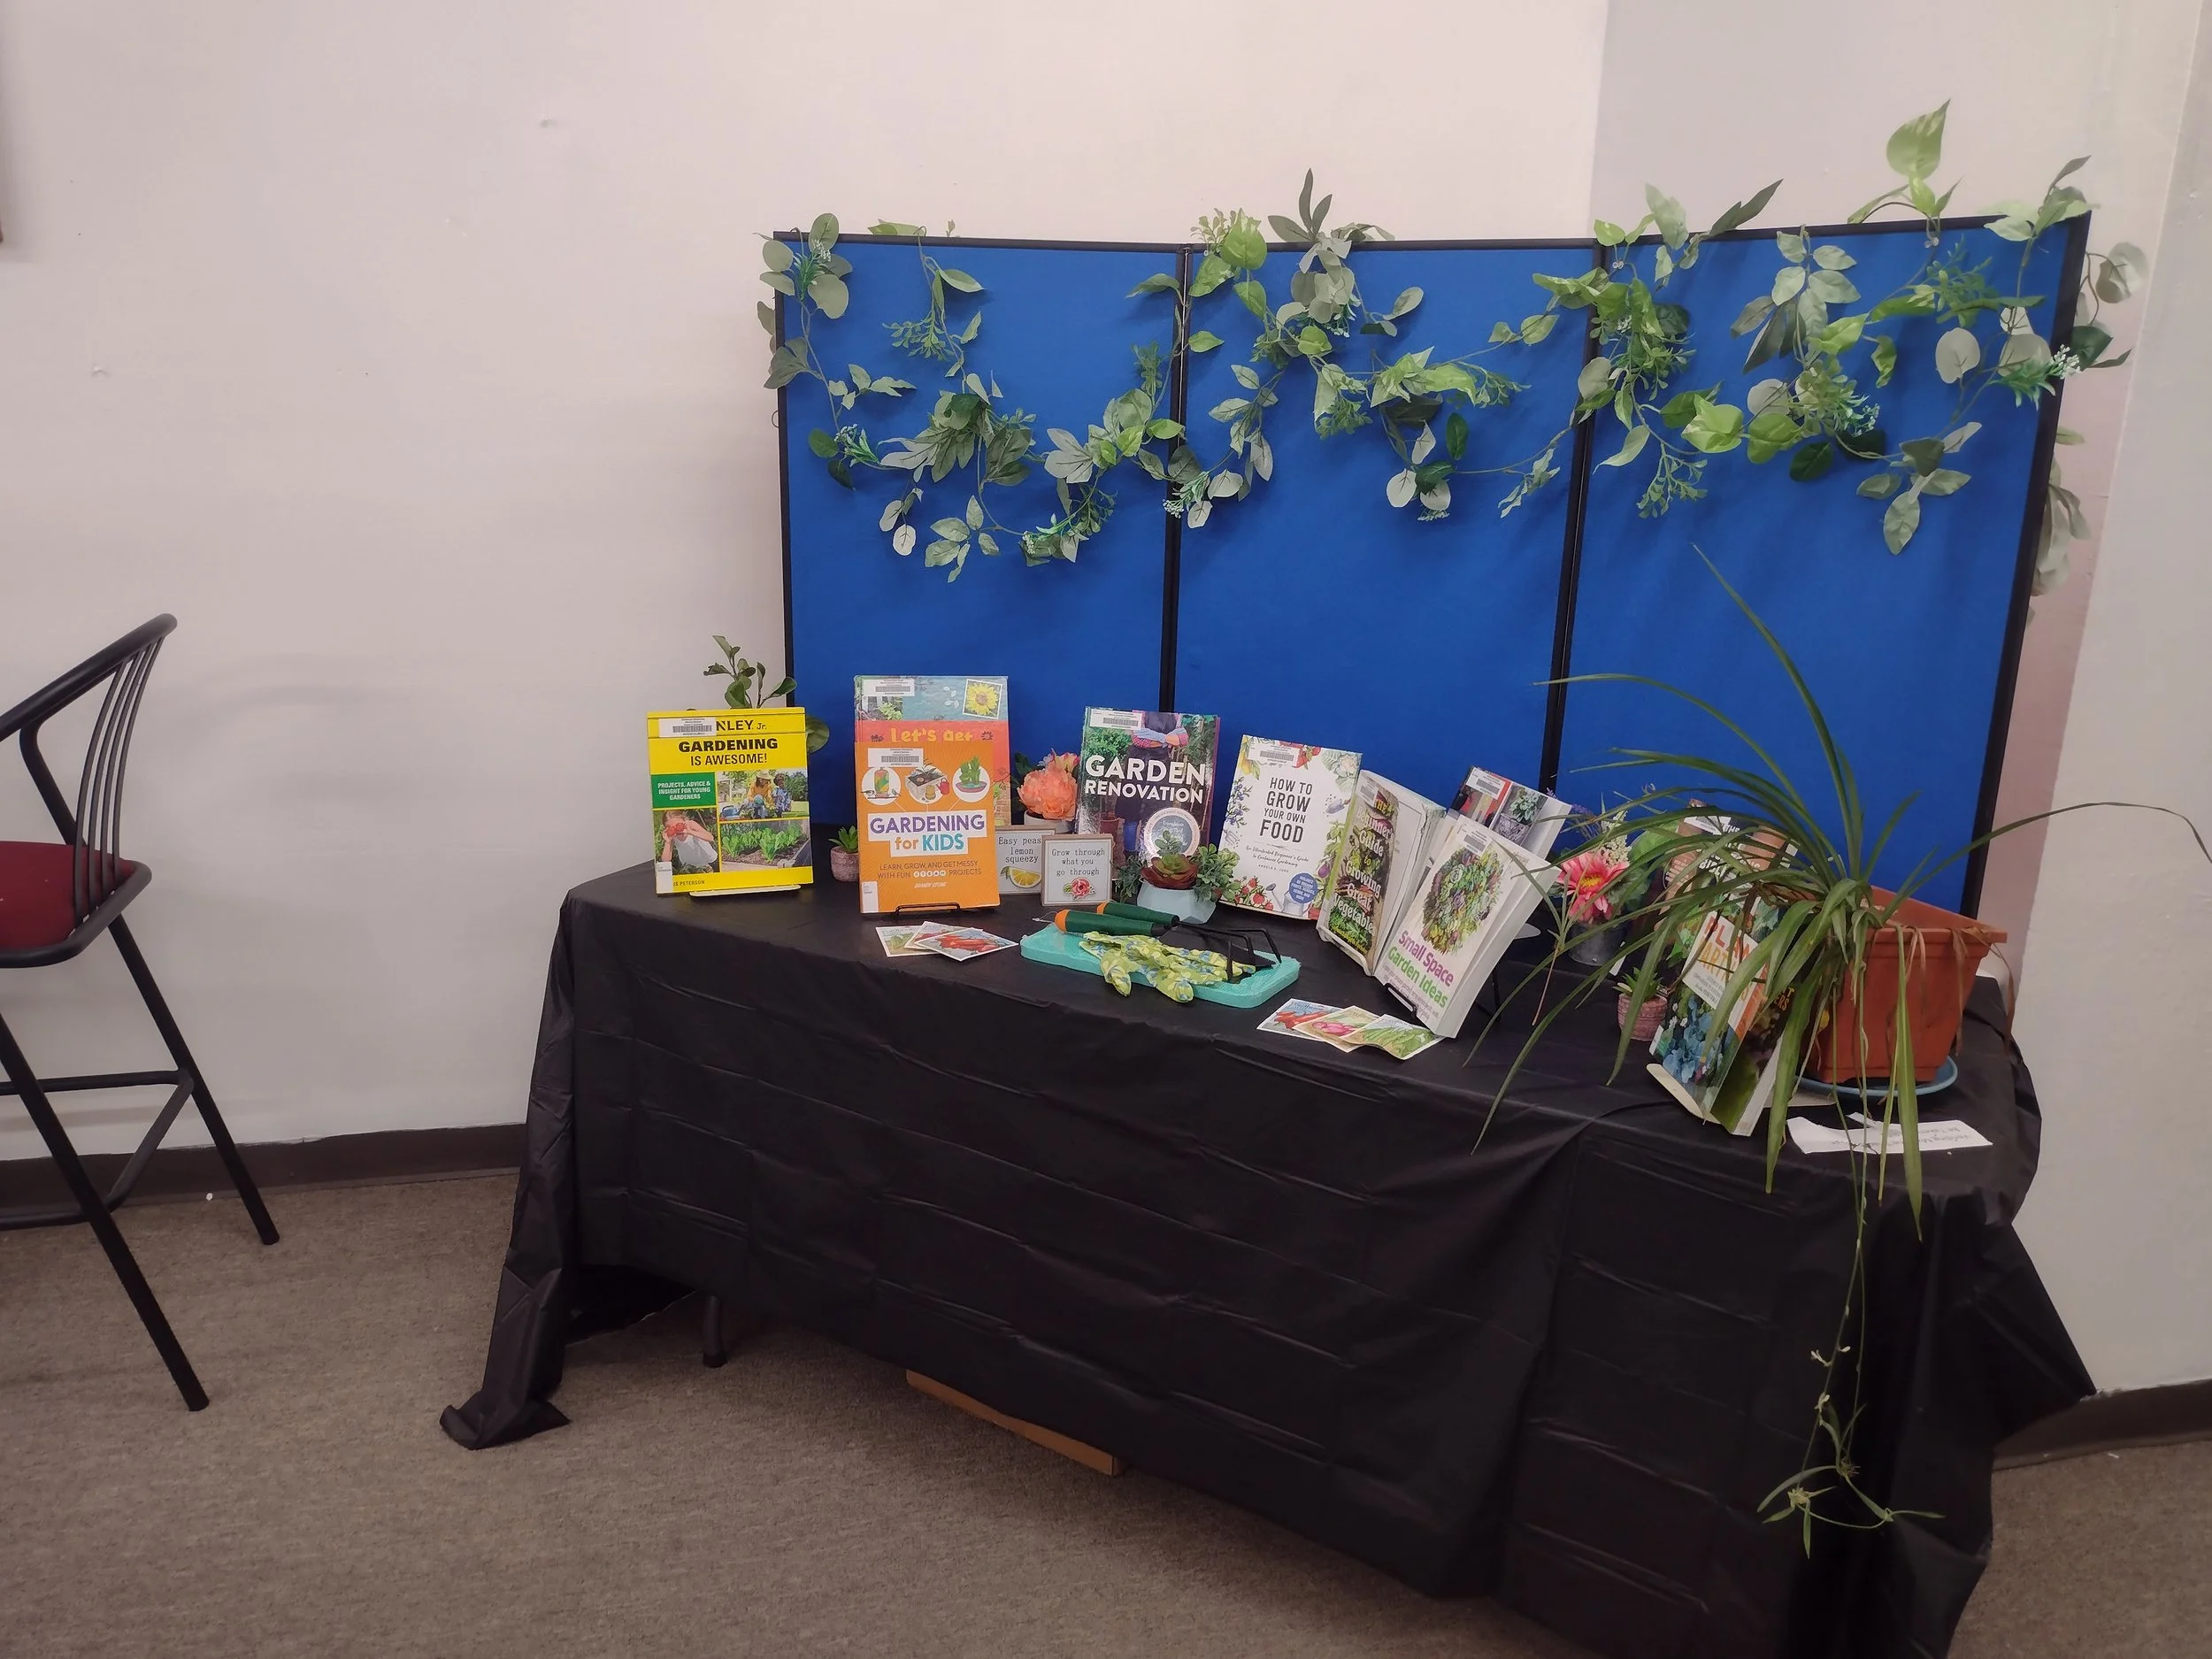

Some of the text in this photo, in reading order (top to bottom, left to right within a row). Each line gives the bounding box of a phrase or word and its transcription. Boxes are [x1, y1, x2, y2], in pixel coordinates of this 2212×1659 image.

[716, 720, 754, 732] NLEY
[890, 727, 937, 742] Let's
[679, 737, 778, 753] GARDENING
[690, 753, 767, 766] IS AWESOME!
[1085, 754, 1206, 787] GARDEN
[1084, 780, 1203, 804] RENOVATION
[1269, 777, 1313, 795] HOW TO
[1266, 790, 1311, 812] GROW
[870, 814, 985, 833] GARDENING
[1263, 808, 1307, 824] YOUR OWN
[1259, 818, 1304, 843] FOOD
[895, 833, 964, 851] for KIDS
[998, 836, 1018, 845] Easy
[1359, 829, 1384, 857] Guide
[1010, 847, 1033, 856] lemon
[1074, 848, 1105, 857] through
[1070, 867, 1100, 877] through
[1346, 860, 1382, 899] Growing
[1347, 883, 1373, 913] Great
[1398, 930, 1426, 962] Small
[1423, 952, 1454, 987] Space
[1387, 946, 1420, 983] Garden
[1418, 974, 1448, 1009] Ideas
